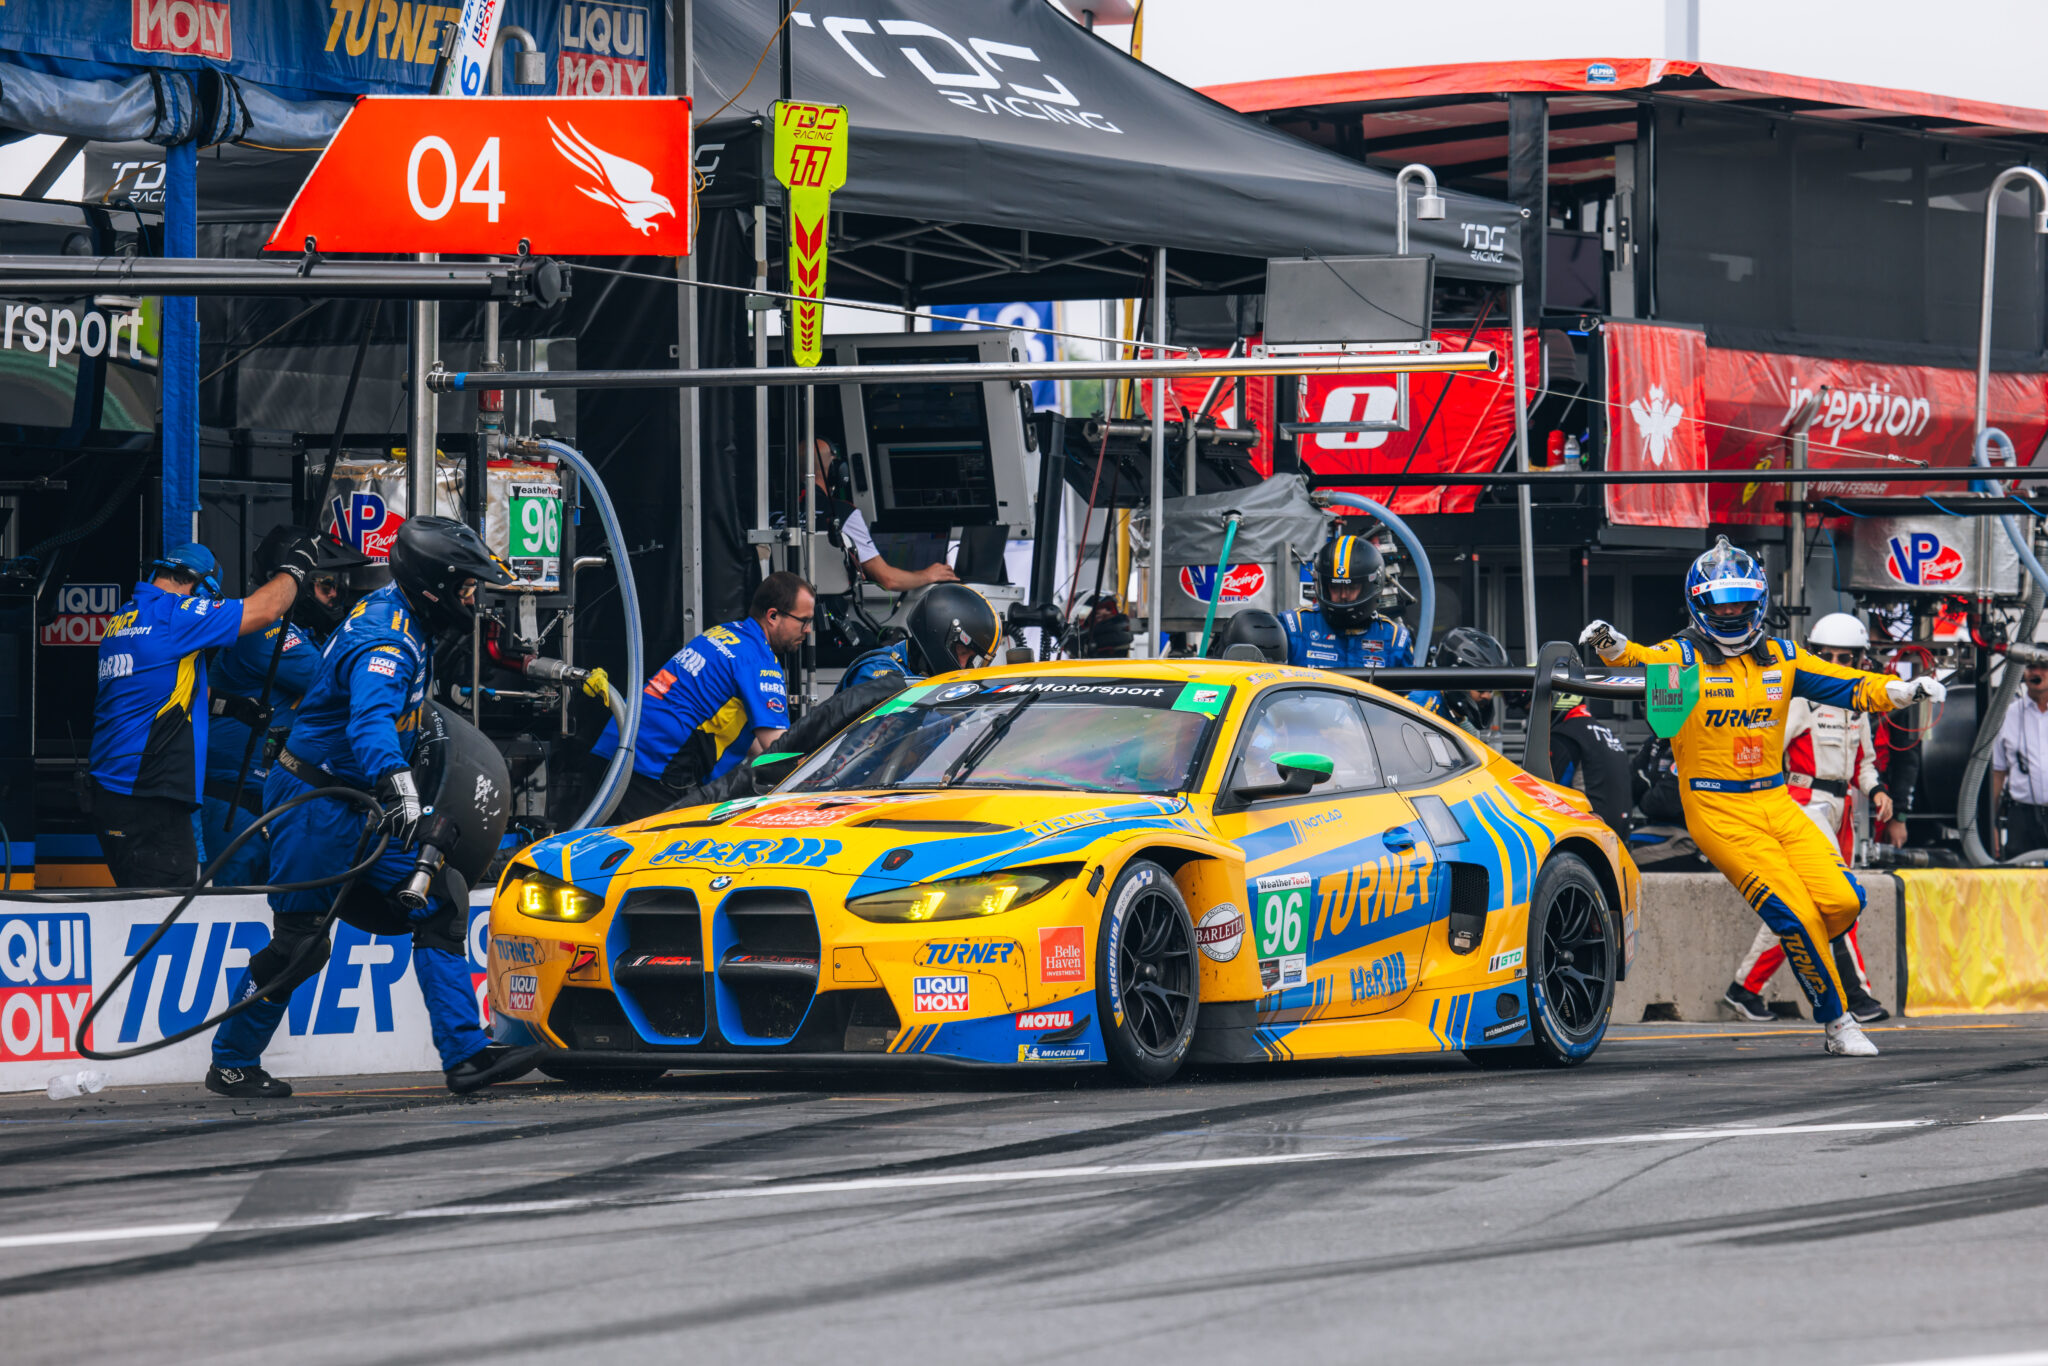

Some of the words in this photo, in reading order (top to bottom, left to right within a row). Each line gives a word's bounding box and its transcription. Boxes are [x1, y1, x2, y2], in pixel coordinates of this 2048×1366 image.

[564, 5, 645, 56] LIQUI
[791, 11, 1080, 106] TDS
[561, 57, 647, 95] MOLY
[783, 104, 840, 130] TDS
[938, 89, 1124, 134] RACING
[793, 129, 833, 141] RACING
[789, 144, 832, 187] 11
[407, 135, 506, 223] 04
[1461, 222, 1506, 251] TDS
[1470, 250, 1504, 263] RACING
[3, 304, 144, 368] rsport
[521, 499, 559, 553] 96
[1890, 533, 1940, 585] VP
[1220, 571, 1265, 592] Racing
[1030, 682, 1164, 698] Motorsport
[1705, 688, 1724, 698] H&R
[1705, 708, 1772, 727] TURNER
[1024, 810, 1109, 837] TURNER
[1303, 809, 1342, 830] NOTLAD
[649, 838, 778, 867] H&R
[1258, 876, 1310, 890] WeatherTech
[1314, 840, 1434, 942] TURNER
[1196, 917, 1244, 943] BARLETTA
[1263, 892, 1303, 955] 96
[0, 919, 85, 985] QUI
[495, 939, 537, 963] TURNER
[926, 943, 1014, 964] TURNER
[1046, 957, 1081, 969] Haven
[1055, 945, 1080, 958] Belle
[1109, 922, 1120, 999] MICHELIN
[1501, 951, 1522, 966] GTD
[1782, 933, 1827, 994] TURNER
[511, 977, 536, 992] LIQUI
[916, 977, 966, 994] LIQUI
[1350, 957, 1391, 1003] H&R
[510, 994, 535, 1009] MOLY
[916, 995, 967, 1010] MOLY
[1018, 1012, 1072, 1028] MOTUL
[1041, 1049, 1085, 1057] MICHELIN
